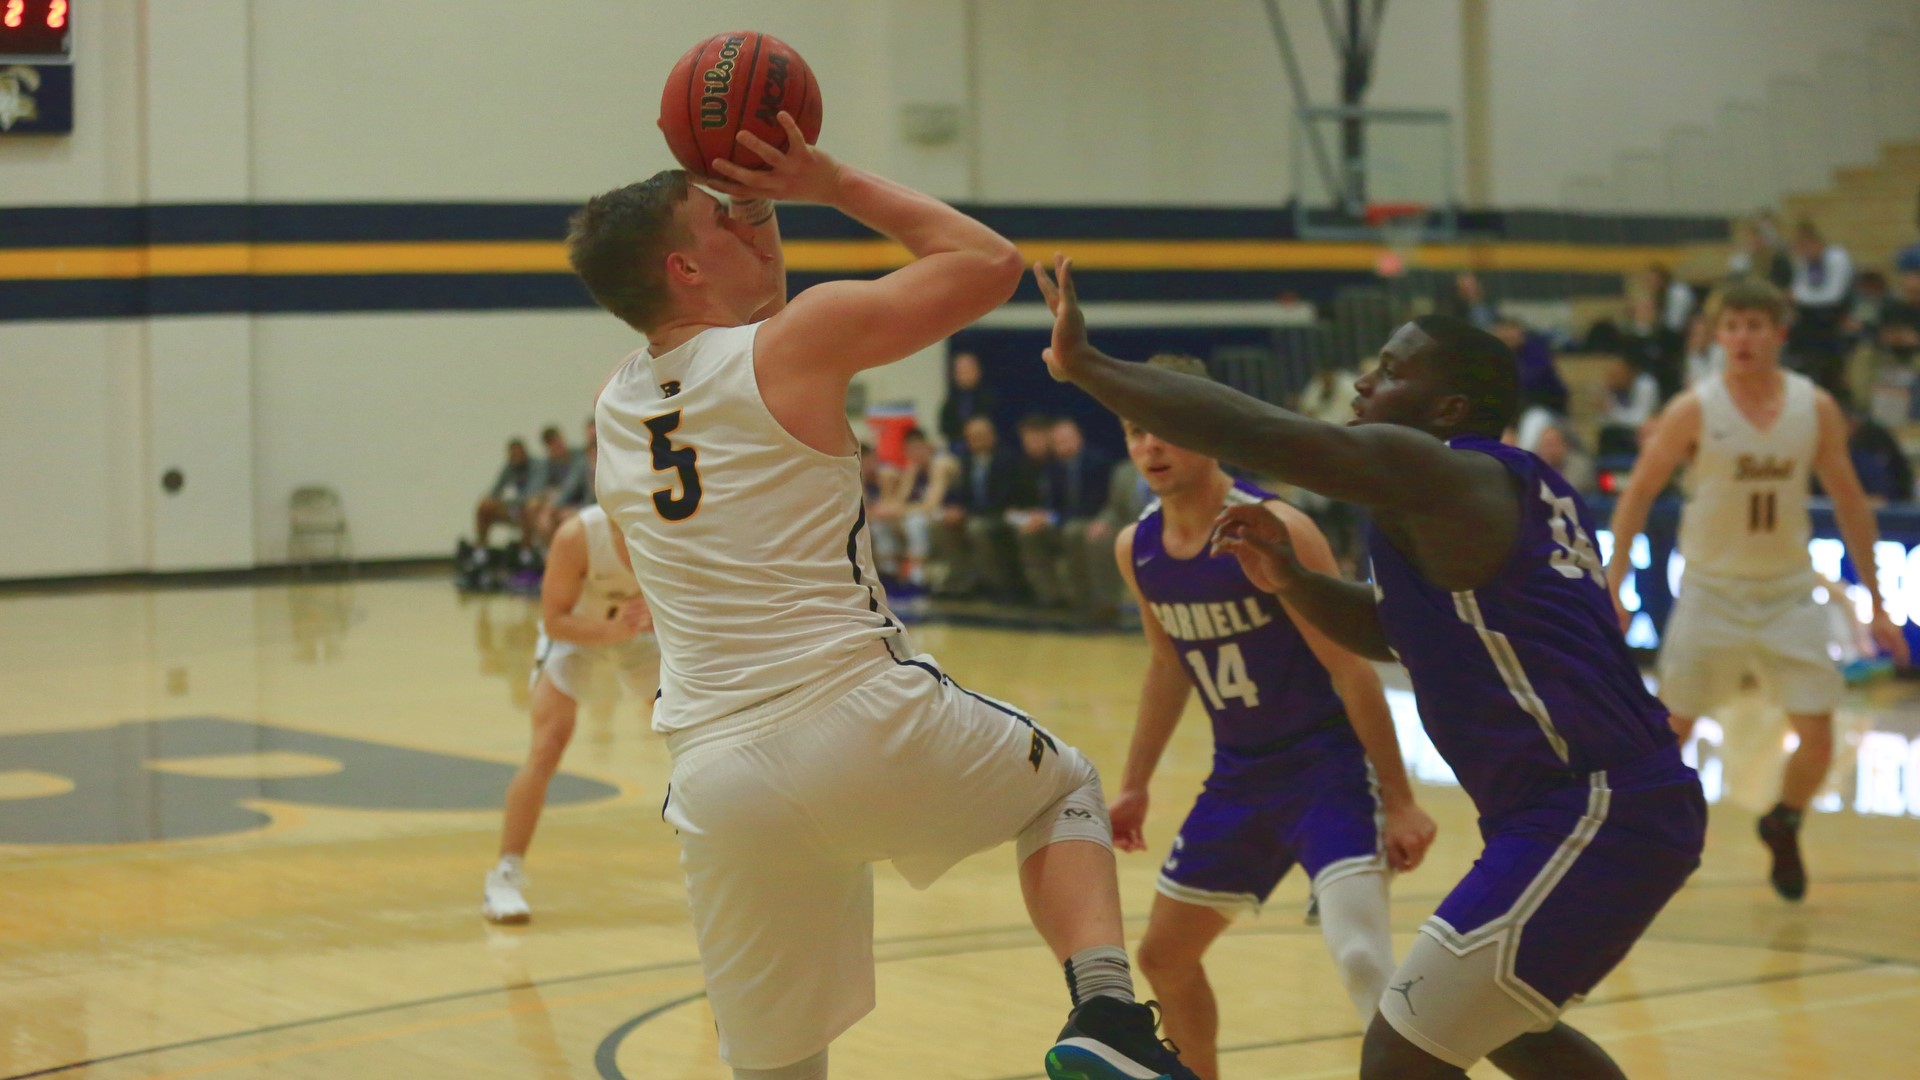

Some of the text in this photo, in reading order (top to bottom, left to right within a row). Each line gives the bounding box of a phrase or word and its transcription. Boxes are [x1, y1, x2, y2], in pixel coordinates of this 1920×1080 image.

[701, 35, 747, 131] Wilson
[640, 406, 704, 523] 5
[1747, 491, 1777, 532] 11
[1185, 643, 1260, 710] 14
